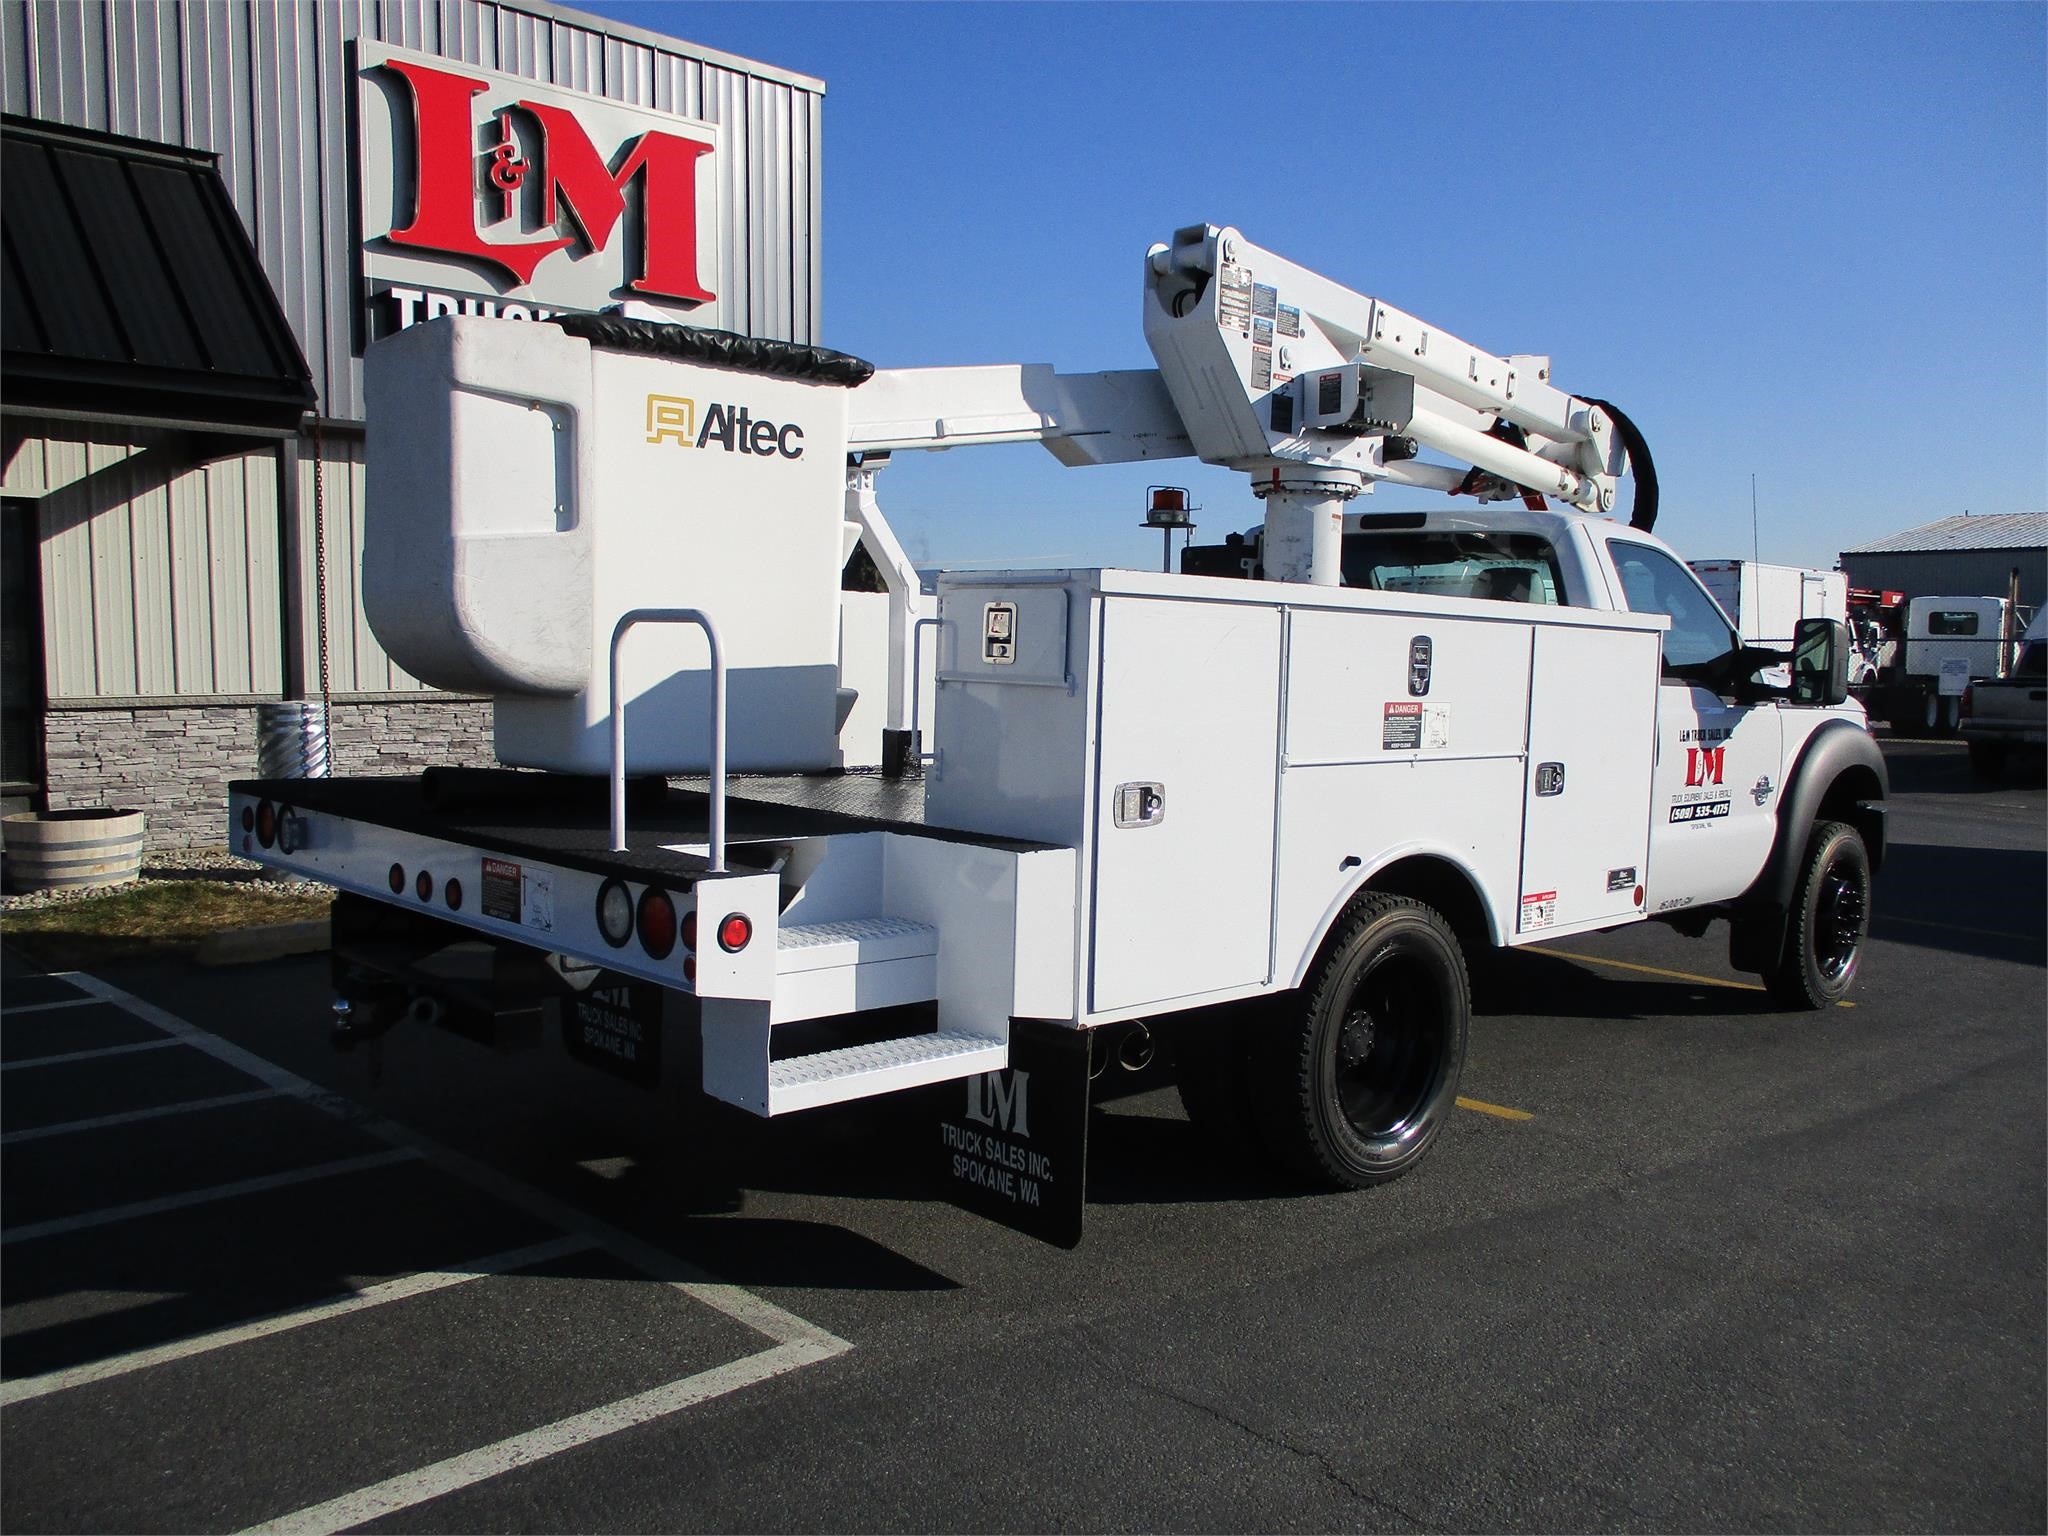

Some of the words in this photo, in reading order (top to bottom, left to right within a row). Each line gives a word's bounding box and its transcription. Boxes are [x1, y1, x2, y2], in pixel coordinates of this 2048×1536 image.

[386, 58, 717, 304] L&M
[696, 402, 804, 460] Altec
[1394, 704, 1419, 713] DANGER
[1671, 806, 1694, 822] (509)
[1695, 804, 1729, 818] 535-4175
[492, 862, 518, 877] DANGER
[941, 1122, 982, 1156] TRUCK
[985, 1136, 1025, 1172] SALES
[1028, 1151, 1054, 1183] INC.
[952, 1153, 1017, 1203] SPOKANE,
[1020, 1177, 1040, 1206] WA
